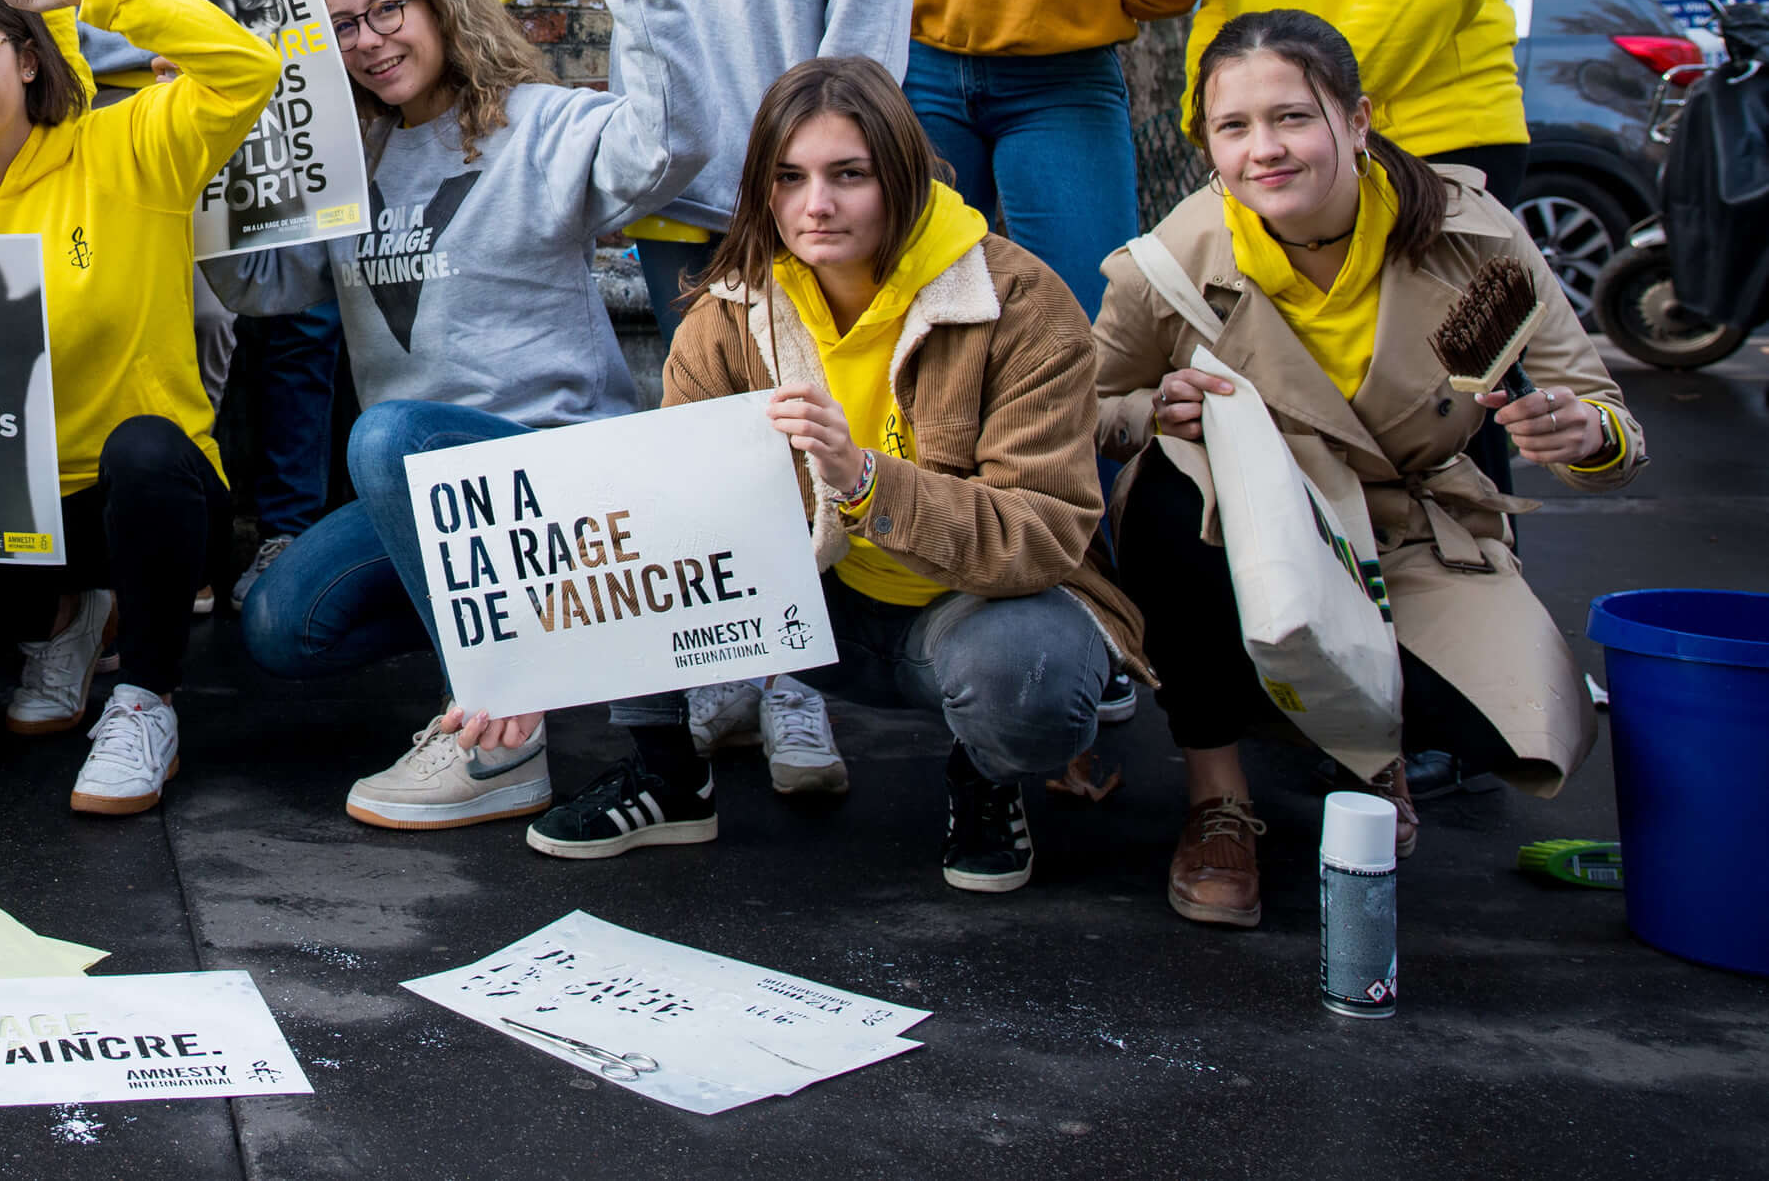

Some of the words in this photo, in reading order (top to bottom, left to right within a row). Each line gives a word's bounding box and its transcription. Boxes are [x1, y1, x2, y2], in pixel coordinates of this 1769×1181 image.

[202, 162, 327, 212] FORTS
[378, 205, 406, 232] ON
[408, 203, 424, 228] A
[354, 233, 375, 259] LA
[378, 227, 433, 256] RAGE
[342, 262, 362, 288] DE
[363, 251, 460, 286] VAINCRE.
[430, 475, 496, 535] ON
[513, 469, 542, 521] A
[439, 536, 500, 592] LA
[509, 510, 640, 580] RAGE
[452, 590, 518, 648] DE
[526, 551, 758, 633] VAINCRE.
[672, 618, 763, 653] AMNESTY
[675, 642, 770, 669] INTERNATIONAL
[126, 1064, 228, 1081] AMNESTY
[129, 1077, 235, 1091] INTERNATIONAL
